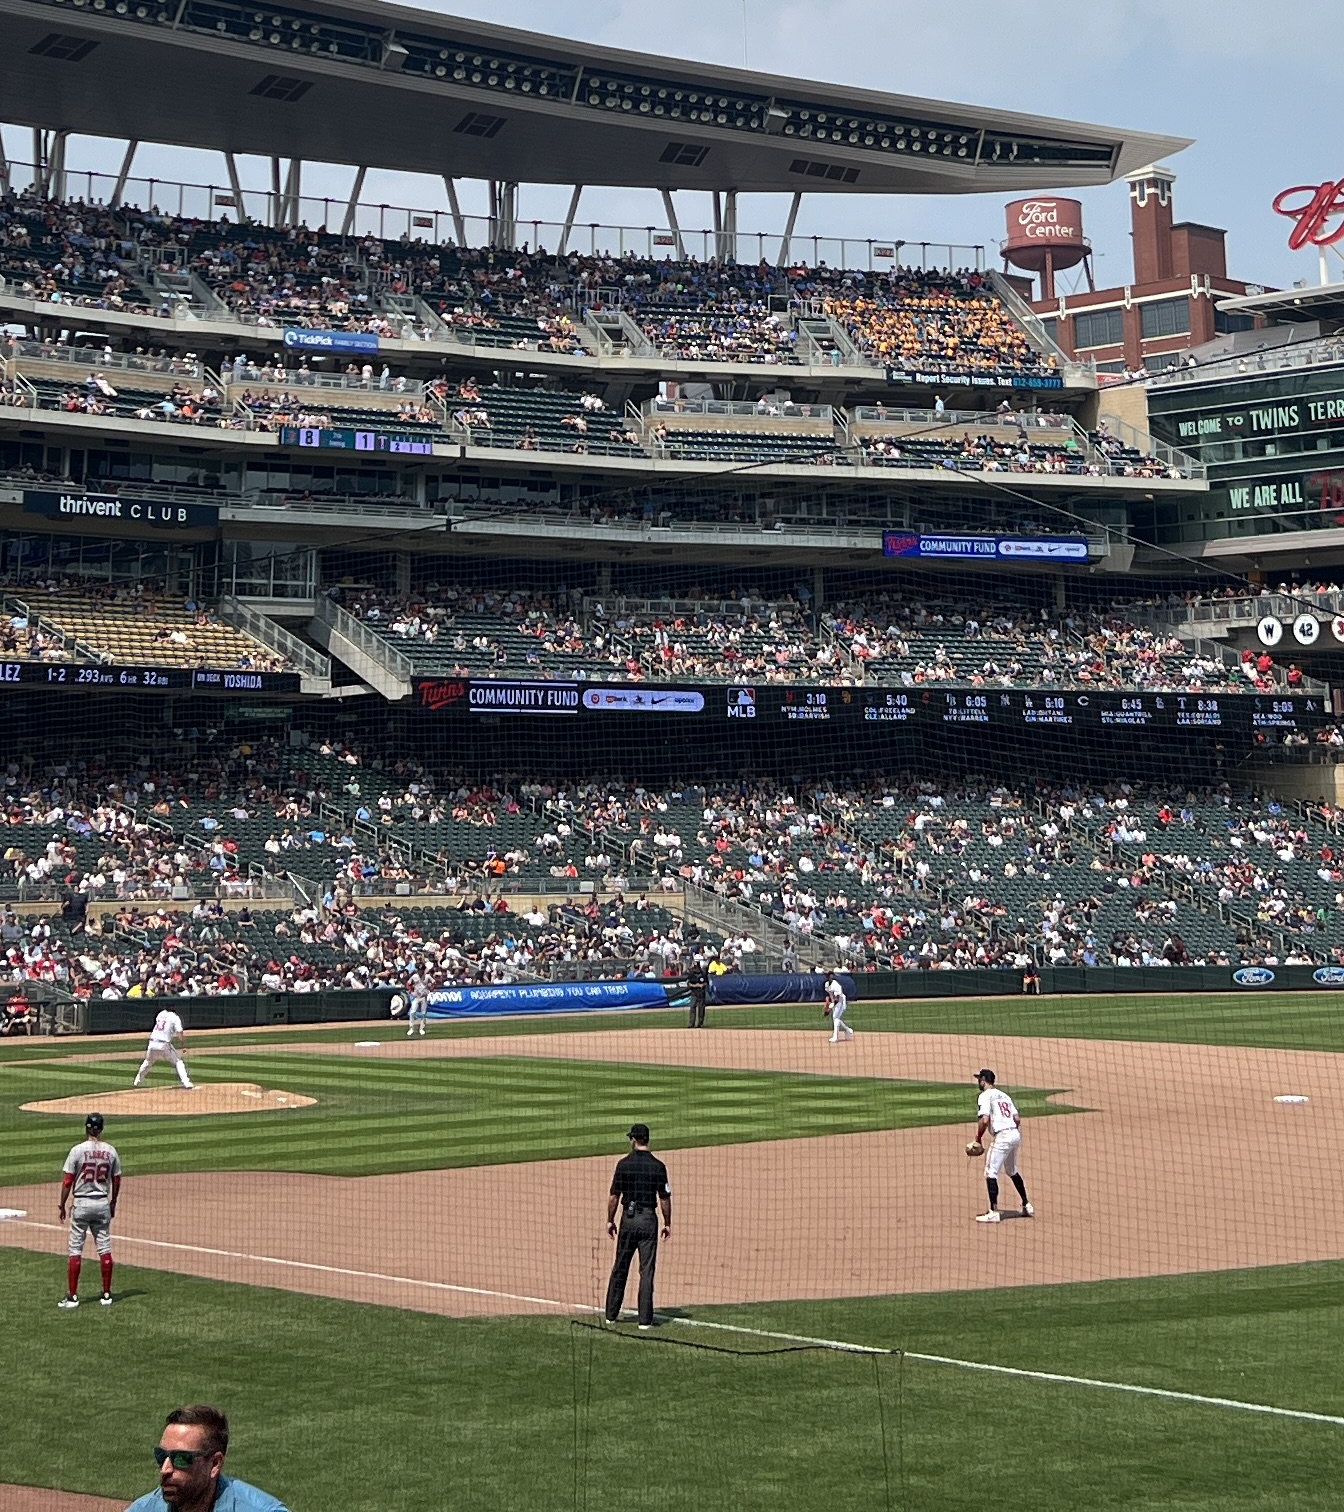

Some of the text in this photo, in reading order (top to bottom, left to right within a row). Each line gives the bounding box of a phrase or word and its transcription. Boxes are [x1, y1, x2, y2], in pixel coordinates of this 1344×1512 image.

[1018, 201, 1058, 225] Ford
[1025, 223, 1074, 238] Center
[297, 333, 333, 346] TickPick
[941, 374, 970, 386] Security
[1178, 417, 1222, 437] WELCOME
[1226, 416, 1244, 427] TO
[1249, 405, 1300, 431] TWINS
[1229, 482, 1303, 509] WE ARE ALL
[59, 495, 188, 522] thrivent CLUB
[919, 539, 971, 553] COMMUNITY
[973, 541, 997, 554] FUND
[1264, 623, 1275, 639] W
[1298, 622, 1314, 637] 42
[47, 667, 66, 682] 1-2
[224, 674, 263, 689] YOSHIDA
[418, 679, 579, 710] Twins COMMUNITY FUND
[806, 693, 826, 705] 3:10
[886, 694, 908, 706] 5:40
[965, 695, 987, 707] 6:05
[1044, 697, 1065, 709] 6:10
[727, 706, 756, 718] MLB
[1242, 968, 1267, 983] Ford
[84, 1150, 110, 1161] FLORES
